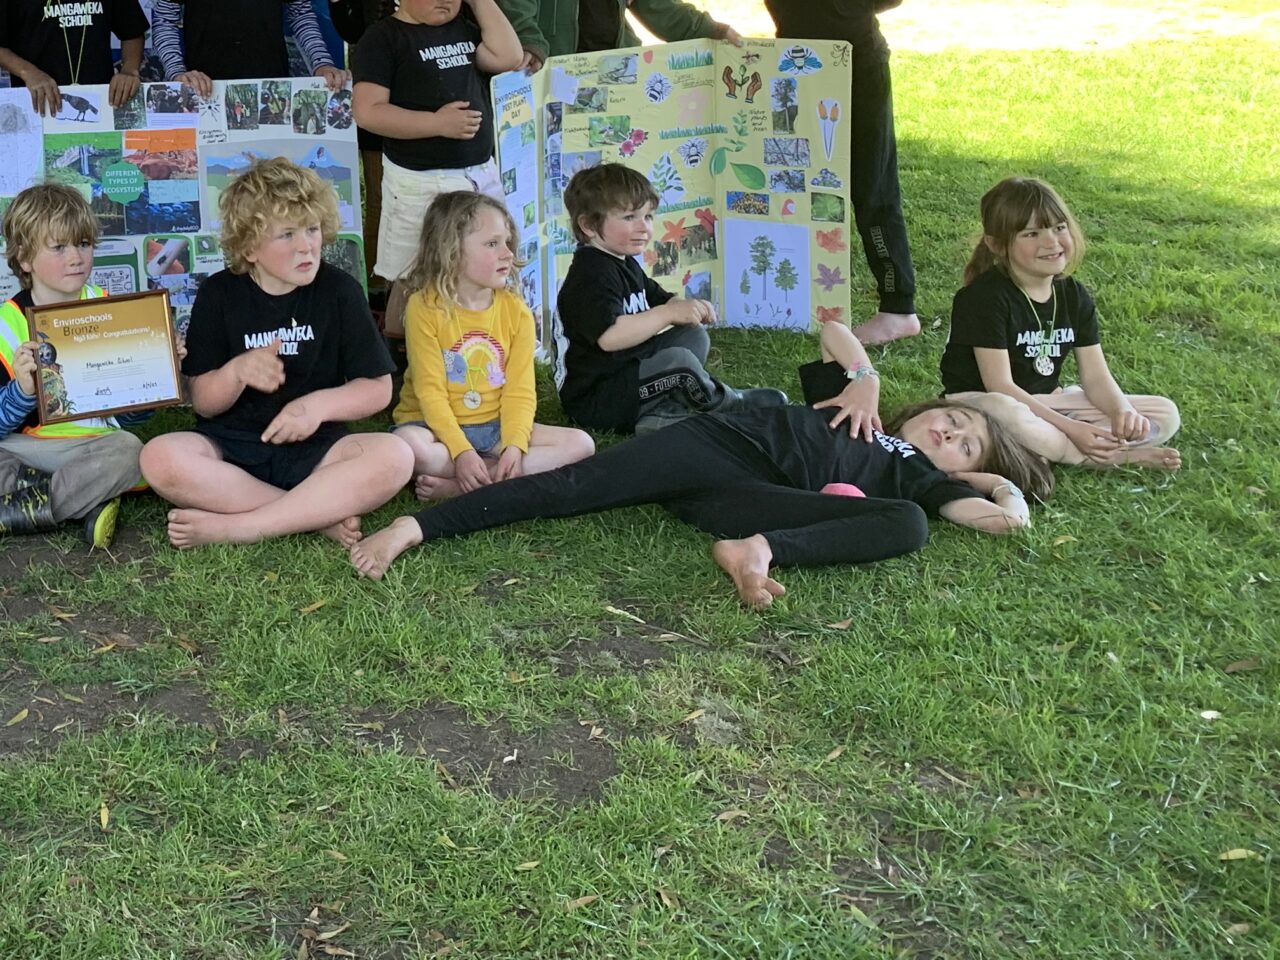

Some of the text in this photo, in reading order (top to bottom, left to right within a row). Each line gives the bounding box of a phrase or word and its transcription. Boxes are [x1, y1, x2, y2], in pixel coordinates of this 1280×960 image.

[43, 1, 103, 19] MANGAWEKA
[59, 15, 93, 28] SCHOOL
[419, 41, 476, 62] MANGAWEKA
[436, 54, 472, 70] SCHOOL
[511, 109, 521, 119] DAY
[53, 313, 113, 328] Enviroschools
[63, 324, 100, 337] Bronze
[103, 326, 151, 338] Congratulations!
[655, 375, 680, 392] FUTURE
